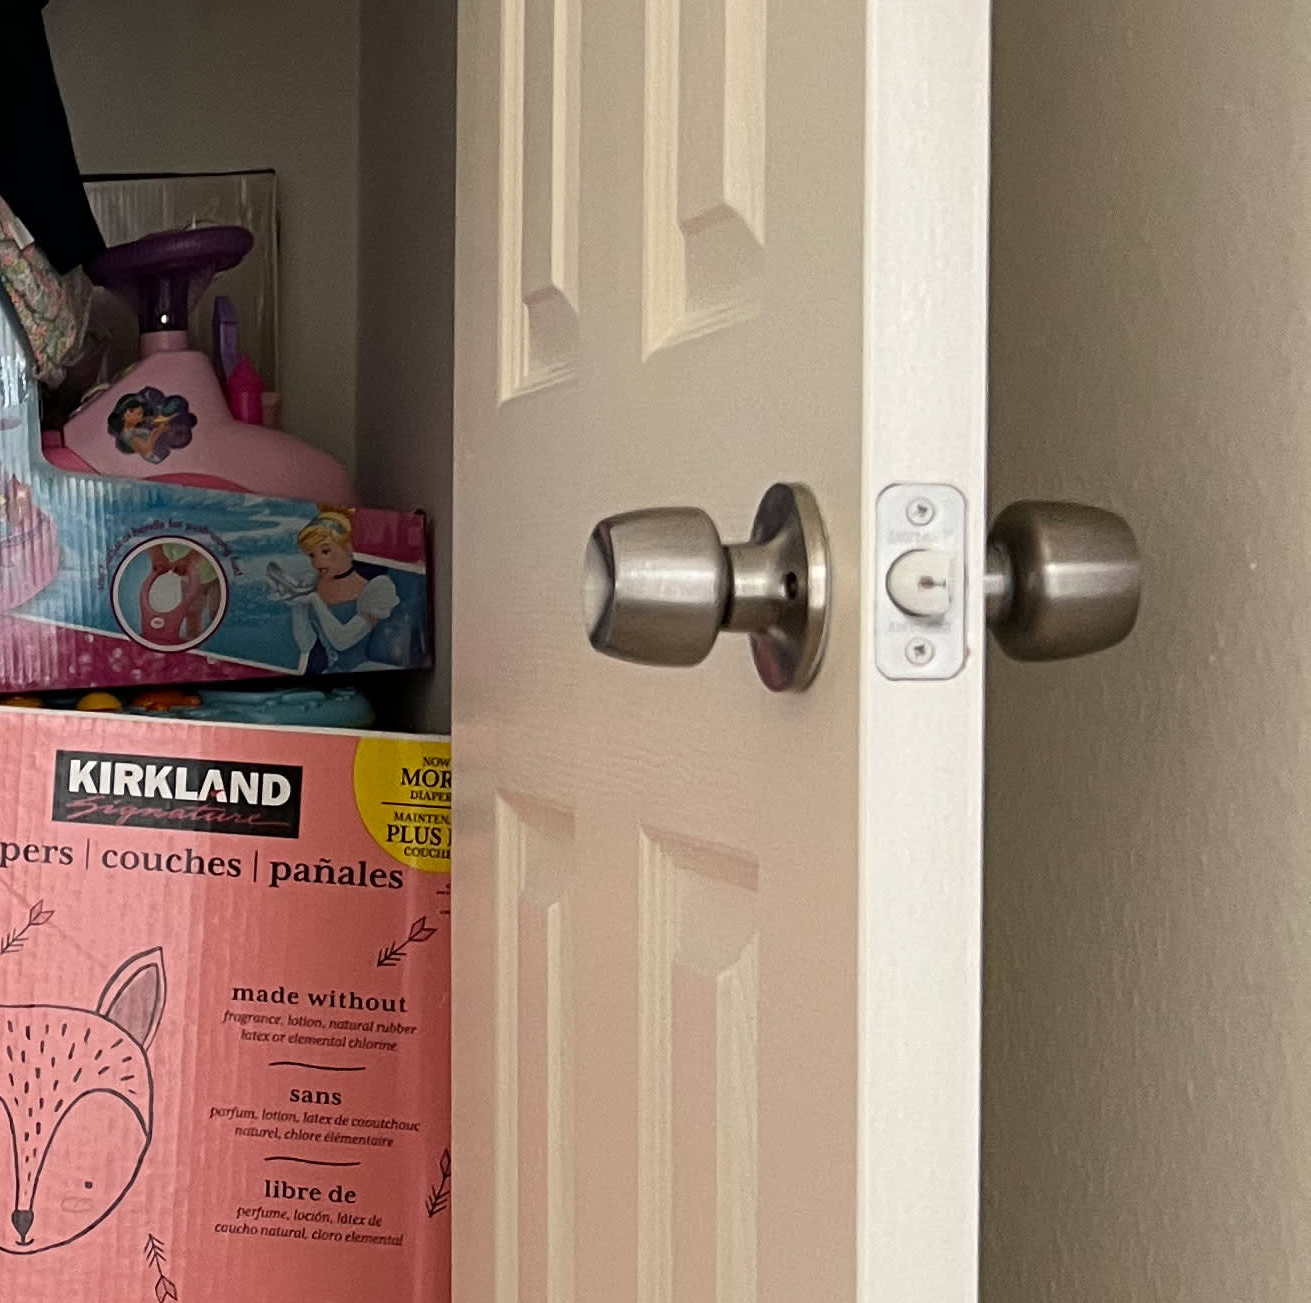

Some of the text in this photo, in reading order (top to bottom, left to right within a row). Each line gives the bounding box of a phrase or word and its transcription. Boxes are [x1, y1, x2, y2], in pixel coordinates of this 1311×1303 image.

[68, 759, 292, 807] KIRKLAND
[65, 794, 290, 827] Signature
[386, 824, 442, 847] PLUS
[101, 847, 242, 878] couches
[268, 857, 403, 890] pañales
[231, 986, 408, 1013] made without
[329, 1017, 374, 1033] natural
[376, 1022, 418, 1035] rubber
[240, 1028, 271, 1043] latex
[272, 1033, 287, 1043] or
[288, 1032, 347, 1048] elemental
[289, 1087, 343, 1106] sans
[303, 1111, 332, 1126] latex
[334, 1114, 350, 1127] de
[351, 1117, 421, 1133] caoutchouc
[284, 1129, 322, 1143] chlore
[264, 1179, 358, 1204] libre de
[367, 1212, 384, 1228] de
[214, 1221, 259, 1237] caucho
[311, 1231, 343, 1243] cloro
[344, 1232, 405, 1247] elemental
